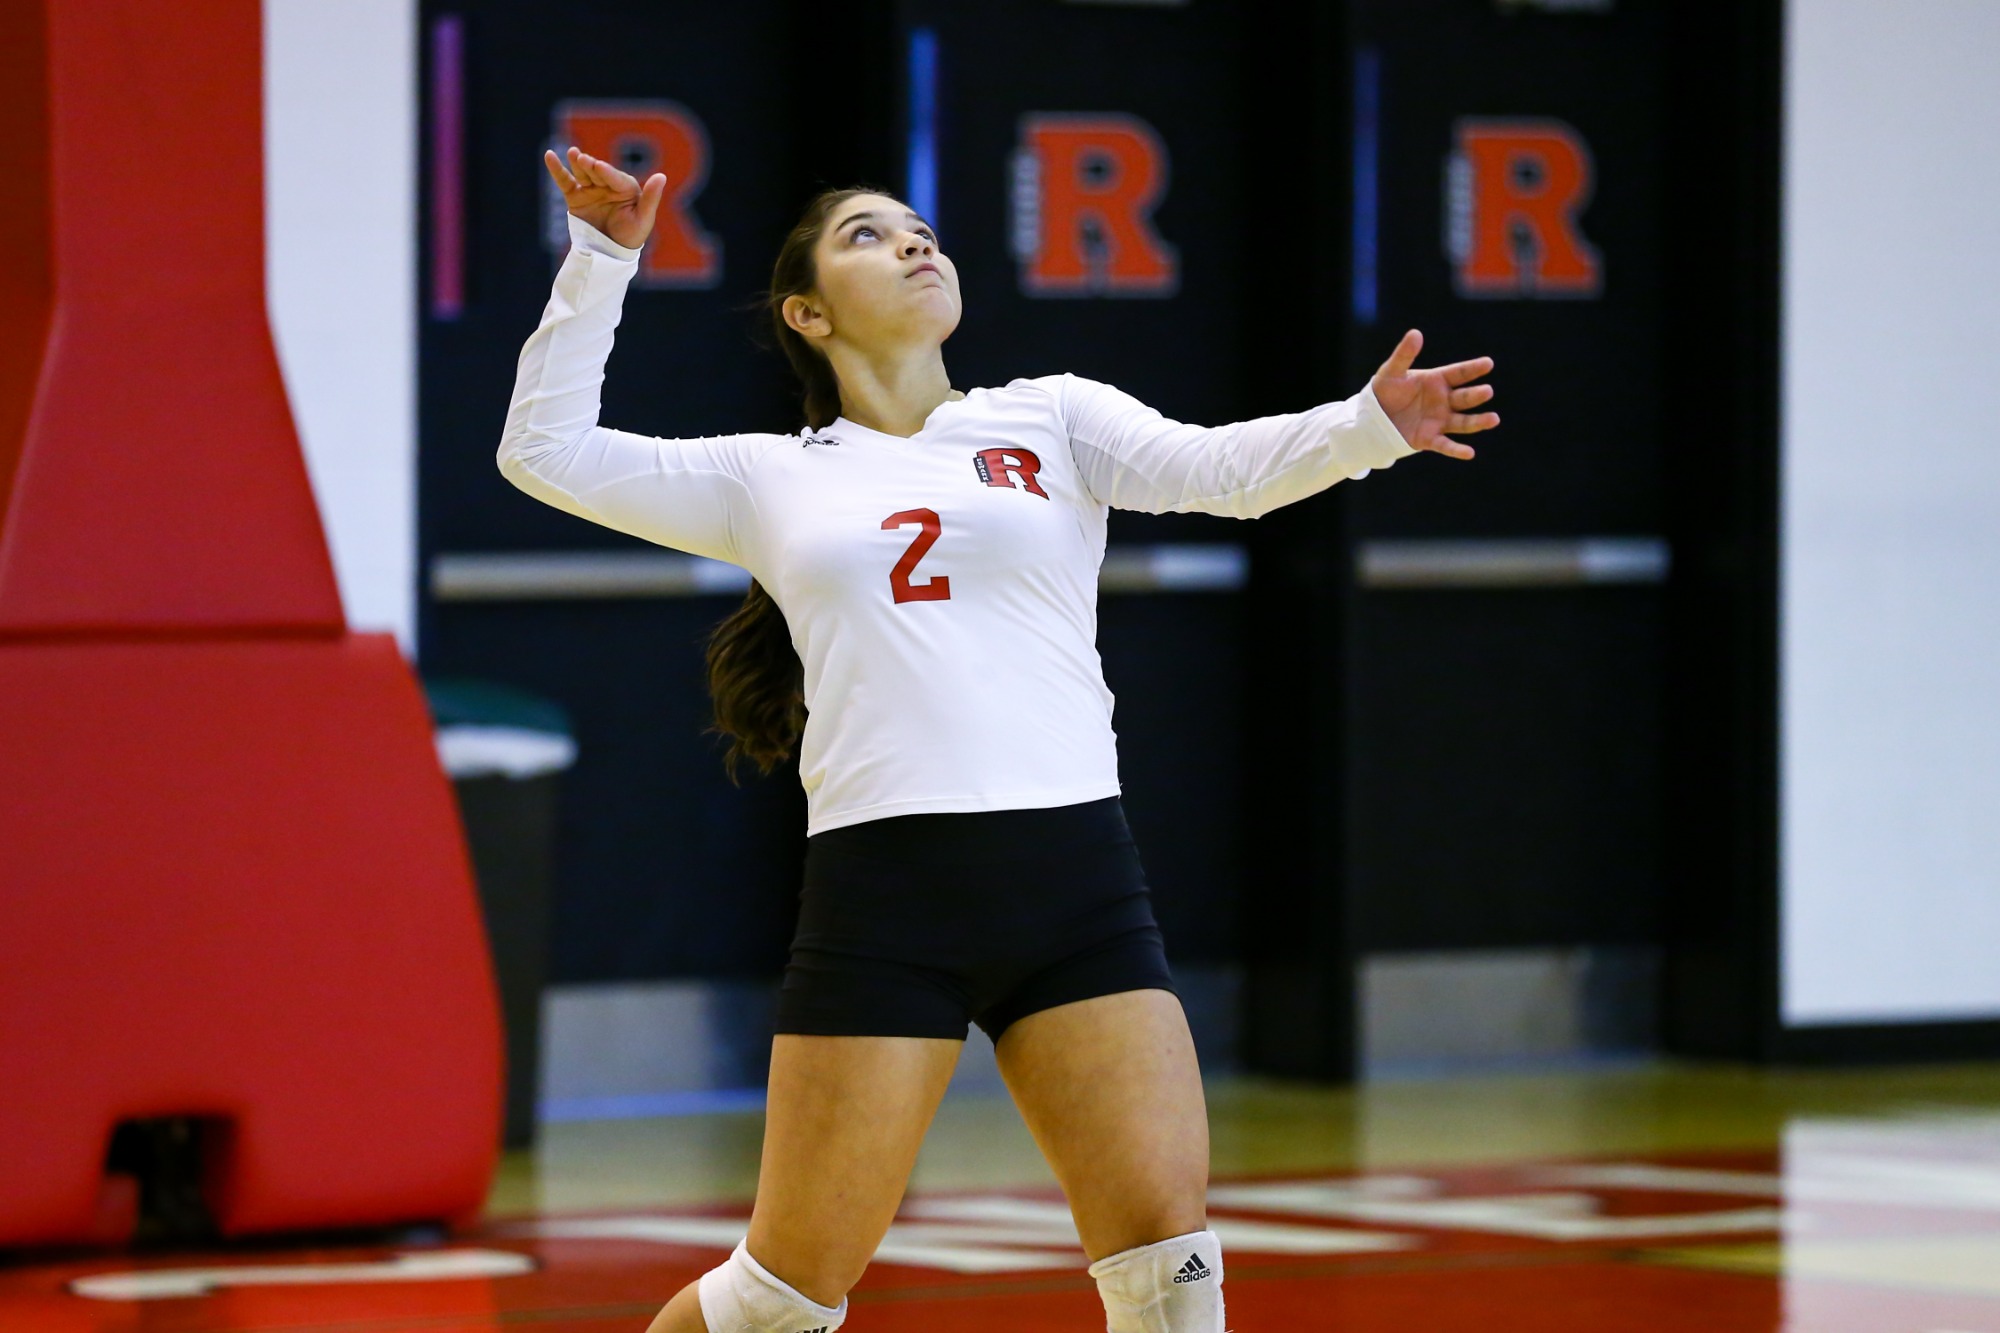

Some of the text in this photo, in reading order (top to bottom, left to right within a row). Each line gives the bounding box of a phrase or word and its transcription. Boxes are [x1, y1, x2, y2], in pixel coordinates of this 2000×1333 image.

[551, 102, 722, 286] R
[1022, 114, 1177, 294] R
[1450, 119, 1602, 297] R
[975, 448, 1049, 500] R
[882, 508, 951, 604] 2
[1173, 1268, 1211, 1284] adidas
